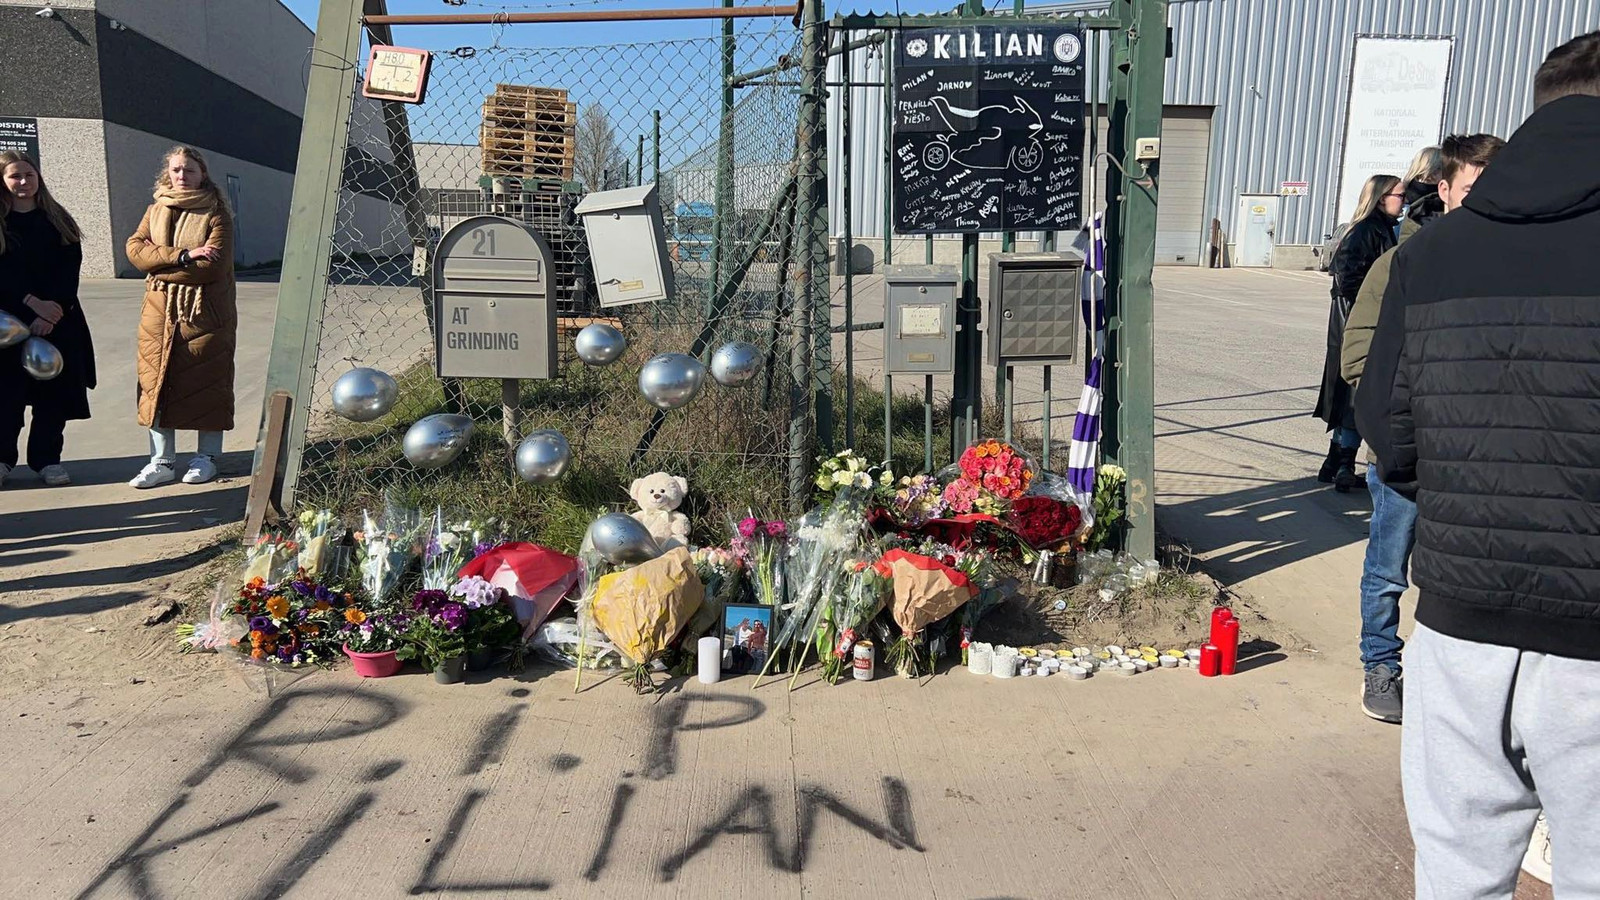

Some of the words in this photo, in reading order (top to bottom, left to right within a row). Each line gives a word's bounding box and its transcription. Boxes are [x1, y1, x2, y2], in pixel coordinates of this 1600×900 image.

[934, 33, 1043, 59] KILIAN
[937, 81, 964, 92] JARNO
[1370, 139, 1415, 148] TRANSPORT
[472, 229, 495, 256] 21
[452, 307, 469, 325] AT
[447, 332, 519, 350] GRINDING
